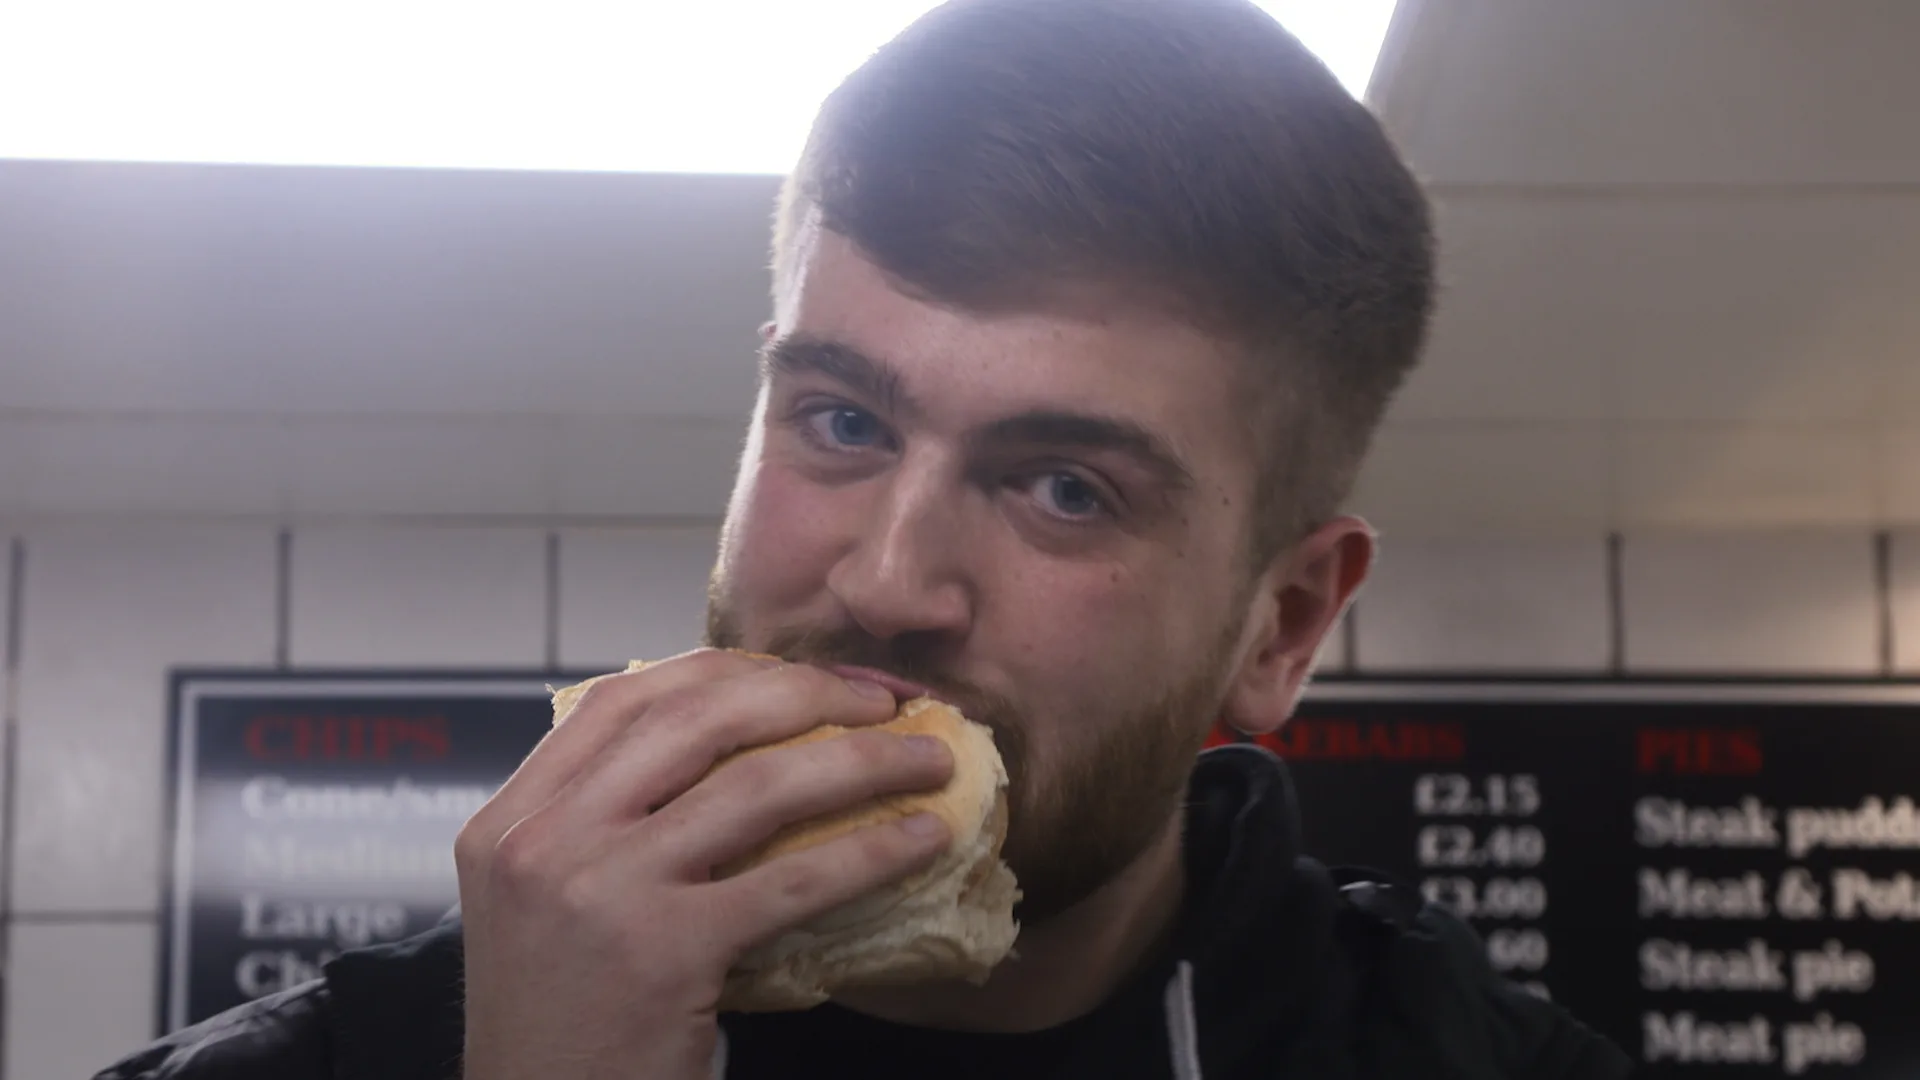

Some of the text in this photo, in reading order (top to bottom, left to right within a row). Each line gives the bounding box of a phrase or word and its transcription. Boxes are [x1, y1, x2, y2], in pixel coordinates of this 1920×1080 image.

[244, 715, 452, 762] CHIPS
[1636, 728, 1764, 774] PIES
[242, 776, 496, 817] Cone/sm
[1415, 775, 1540, 814] £2.15
[1419, 827, 1545, 865] £2.40
[1636, 797, 1920, 856] Steak pudd
[1421, 878, 1546, 919] £3.00
[1640, 869, 1920, 919] Meat & Pot
[242, 895, 407, 948] Large
[1640, 939, 1874, 1001] Steak pie
[1644, 1012, 1865, 1074] Meat pie
